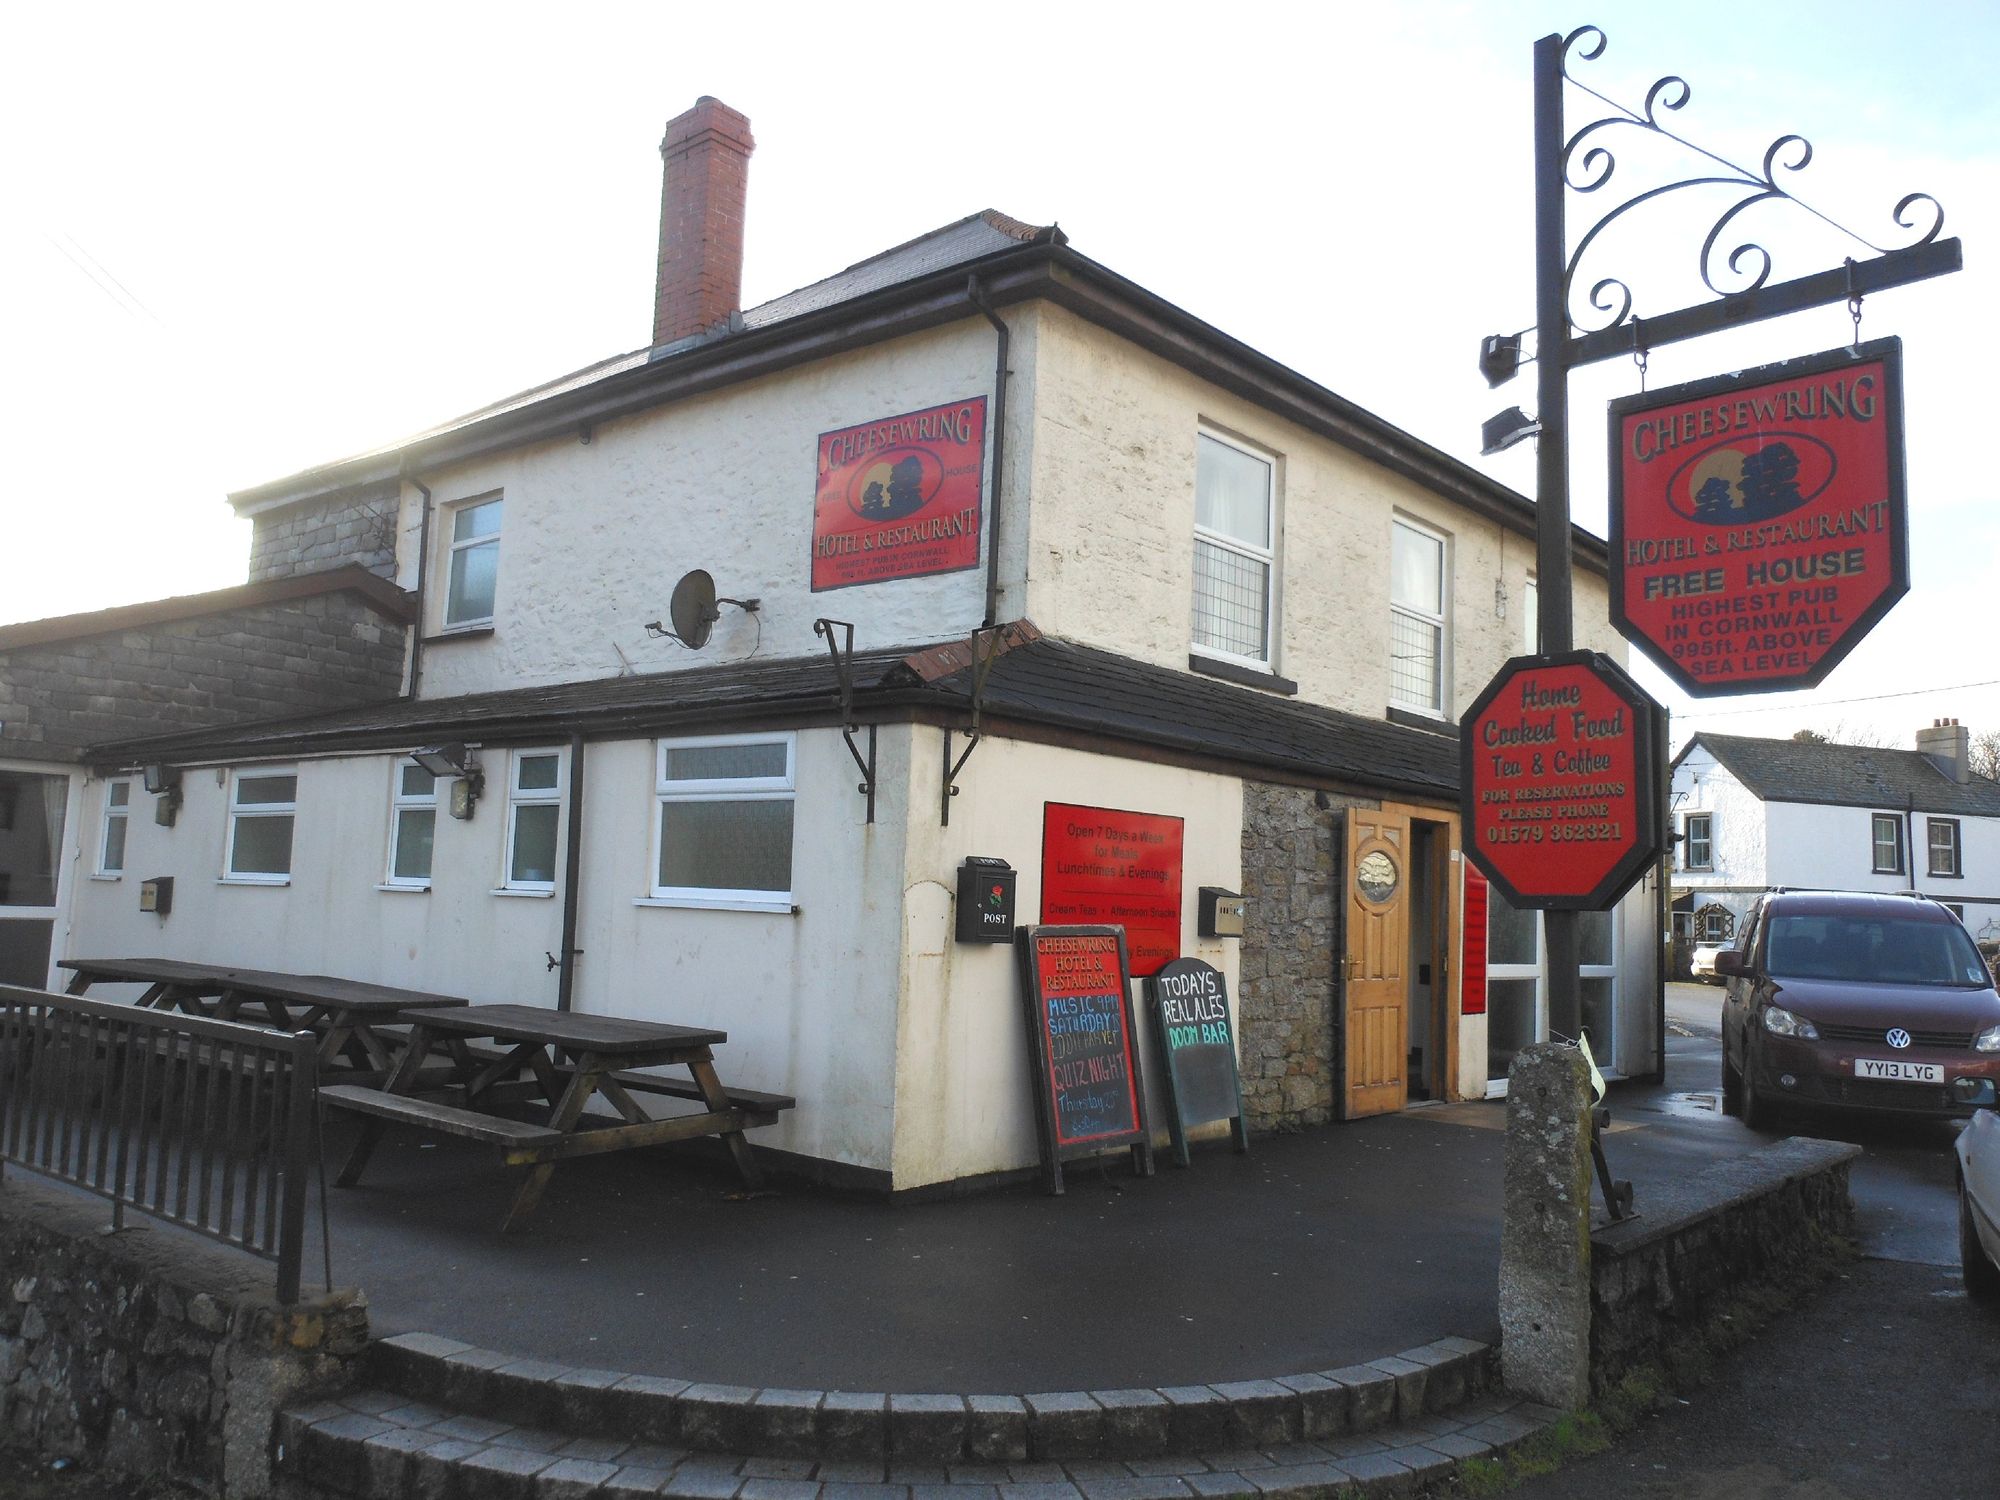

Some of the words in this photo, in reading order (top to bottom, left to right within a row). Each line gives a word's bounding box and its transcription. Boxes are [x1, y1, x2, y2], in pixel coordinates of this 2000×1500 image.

[1632, 374, 1877, 463] CHEESEWRING
[828, 407, 972, 471] CHEESEWRING
[946, 464, 977, 477] HOUSE
[816, 534, 859, 559] HOTEL
[864, 535, 874, 551] &
[878, 508, 976, 548] RESTAURANT
[1626, 537, 1697, 567] HOTEL
[1704, 535, 1720, 554] &
[1727, 500, 1888, 551] RESTAURANT
[902, 548, 949, 560] CORNWALL
[1643, 567, 1725, 601] FREE
[1746, 548, 1867, 588] HOUSE
[1671, 592, 1780, 620] HIGHEST
[1788, 587, 1838, 606] PUB
[1665, 625, 1688, 640] IN
[1700, 607, 1843, 638] CORNWALL
[1671, 638, 1739, 659] 995ft.
[1745, 629, 1831, 652] ABOVE
[1691, 661, 1734, 676] SEA
[1743, 653, 1813, 673] LEVEL
[1521, 680, 1582, 711] Home
[1484, 714, 1557, 748] Cooked
[1571, 708, 1625, 741] Food
[1491, 755, 1522, 778] Tea
[1531, 752, 1544, 776] &
[1553, 748, 1611, 779] Coffee
[1482, 789, 1510, 805] FOR
[1515, 782, 1625, 803] RESERVATIONS
[1499, 805, 1552, 822] PLEASE
[1557, 803, 1609, 819] PHONE
[1067, 823, 1094, 839] Open
[1097, 826, 1102, 837] 7
[1105, 827, 1129, 844] Days
[1131, 833, 1137, 842] a
[1140, 831, 1164, 843] Week
[1487, 825, 1544, 844] 01579
[1550, 823, 1621, 841] 362321
[1094, 847, 1107, 857] for
[1057, 863, 1116, 877] Lunchtimes
[1119, 865, 1125, 877] &
[1128, 865, 1170, 883] Evenings
[984, 913, 1007, 924] POST
[1049, 903, 1076, 914] Cream
[1079, 904, 1097, 915] Teas
[1110, 906, 1148, 917] Afternoon
[1150, 908, 1176, 919] Snacks
[1036, 937, 1116, 955] CHEESEWRING
[1137, 945, 1174, 960] Evenings
[1055, 957, 1092, 974] HOTEL
[1094, 956, 1103, 973] &
[1046, 974, 1115, 992] RESTAURANT
[1161, 971, 1216, 998] TODAYS
[1048, 995, 1095, 1017] MUSIC
[1163, 999, 1194, 1024] REAL
[1193, 994, 1226, 1021] ALES
[1048, 1012, 1111, 1035] SATURDAY
[1169, 1026, 1198, 1050] DOOM
[1202, 1021, 1229, 1045] BAR
[1054, 1061, 1088, 1091] QUIZ
[1088, 1052, 1126, 1084] NIGHT
[1865, 1062, 1899, 1077] YY13
[1904, 1065, 1934, 1080] LYG
